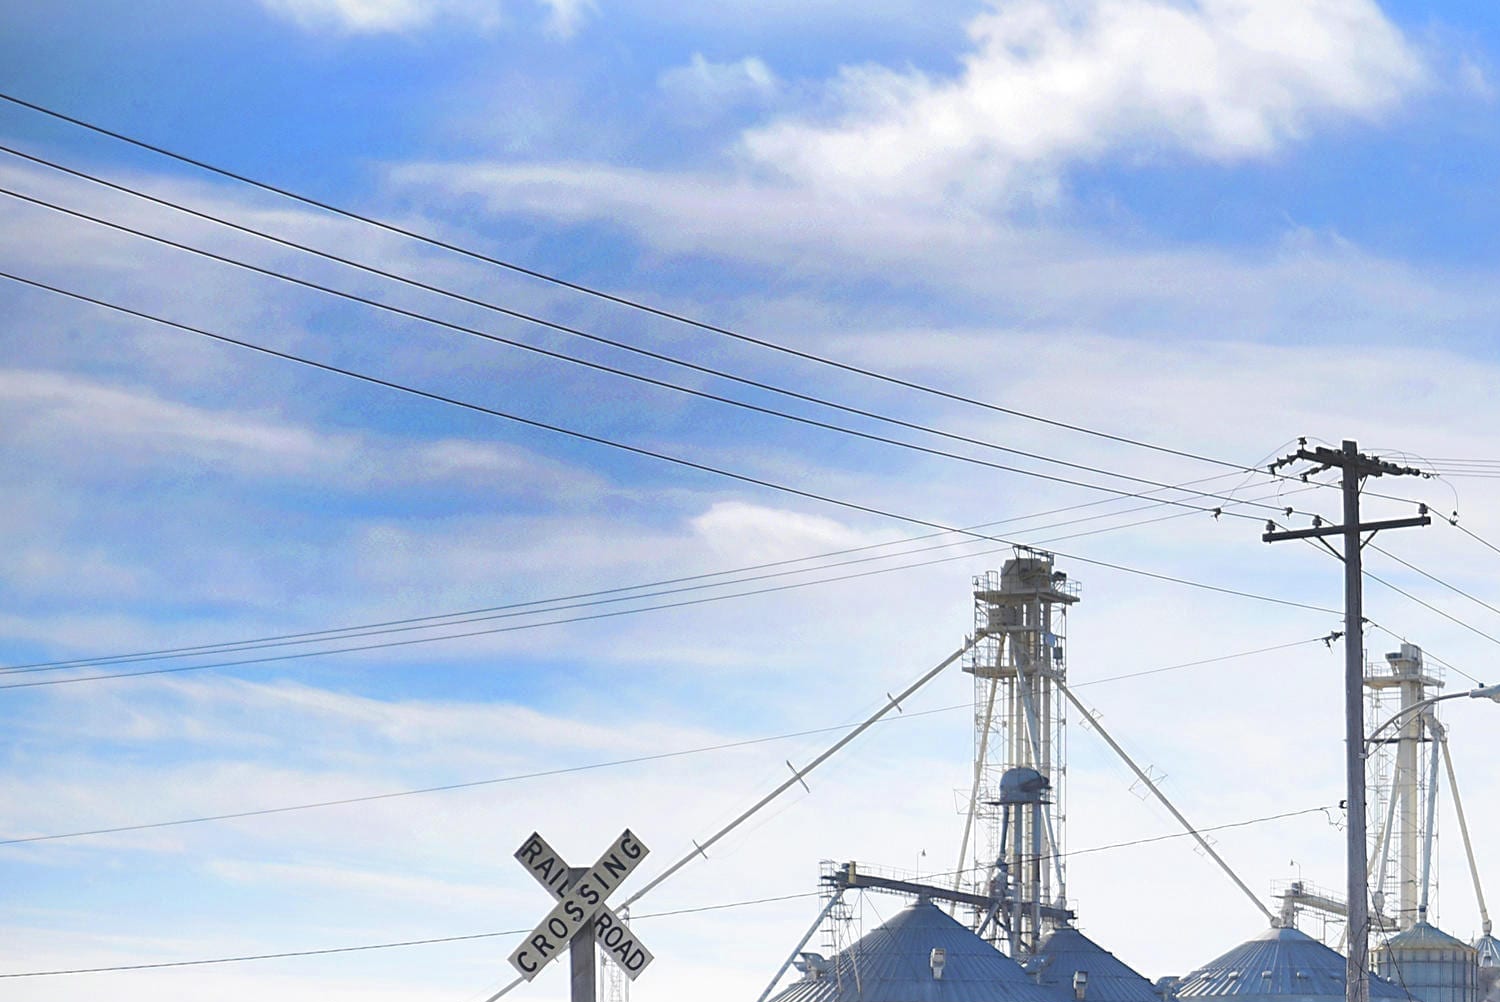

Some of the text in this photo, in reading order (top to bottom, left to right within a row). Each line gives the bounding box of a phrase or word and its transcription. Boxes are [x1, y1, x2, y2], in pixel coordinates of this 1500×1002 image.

[521, 839, 568, 898] RAIL
[517, 837, 641, 973] CROSSING
[594, 912, 645, 971] ROAD
